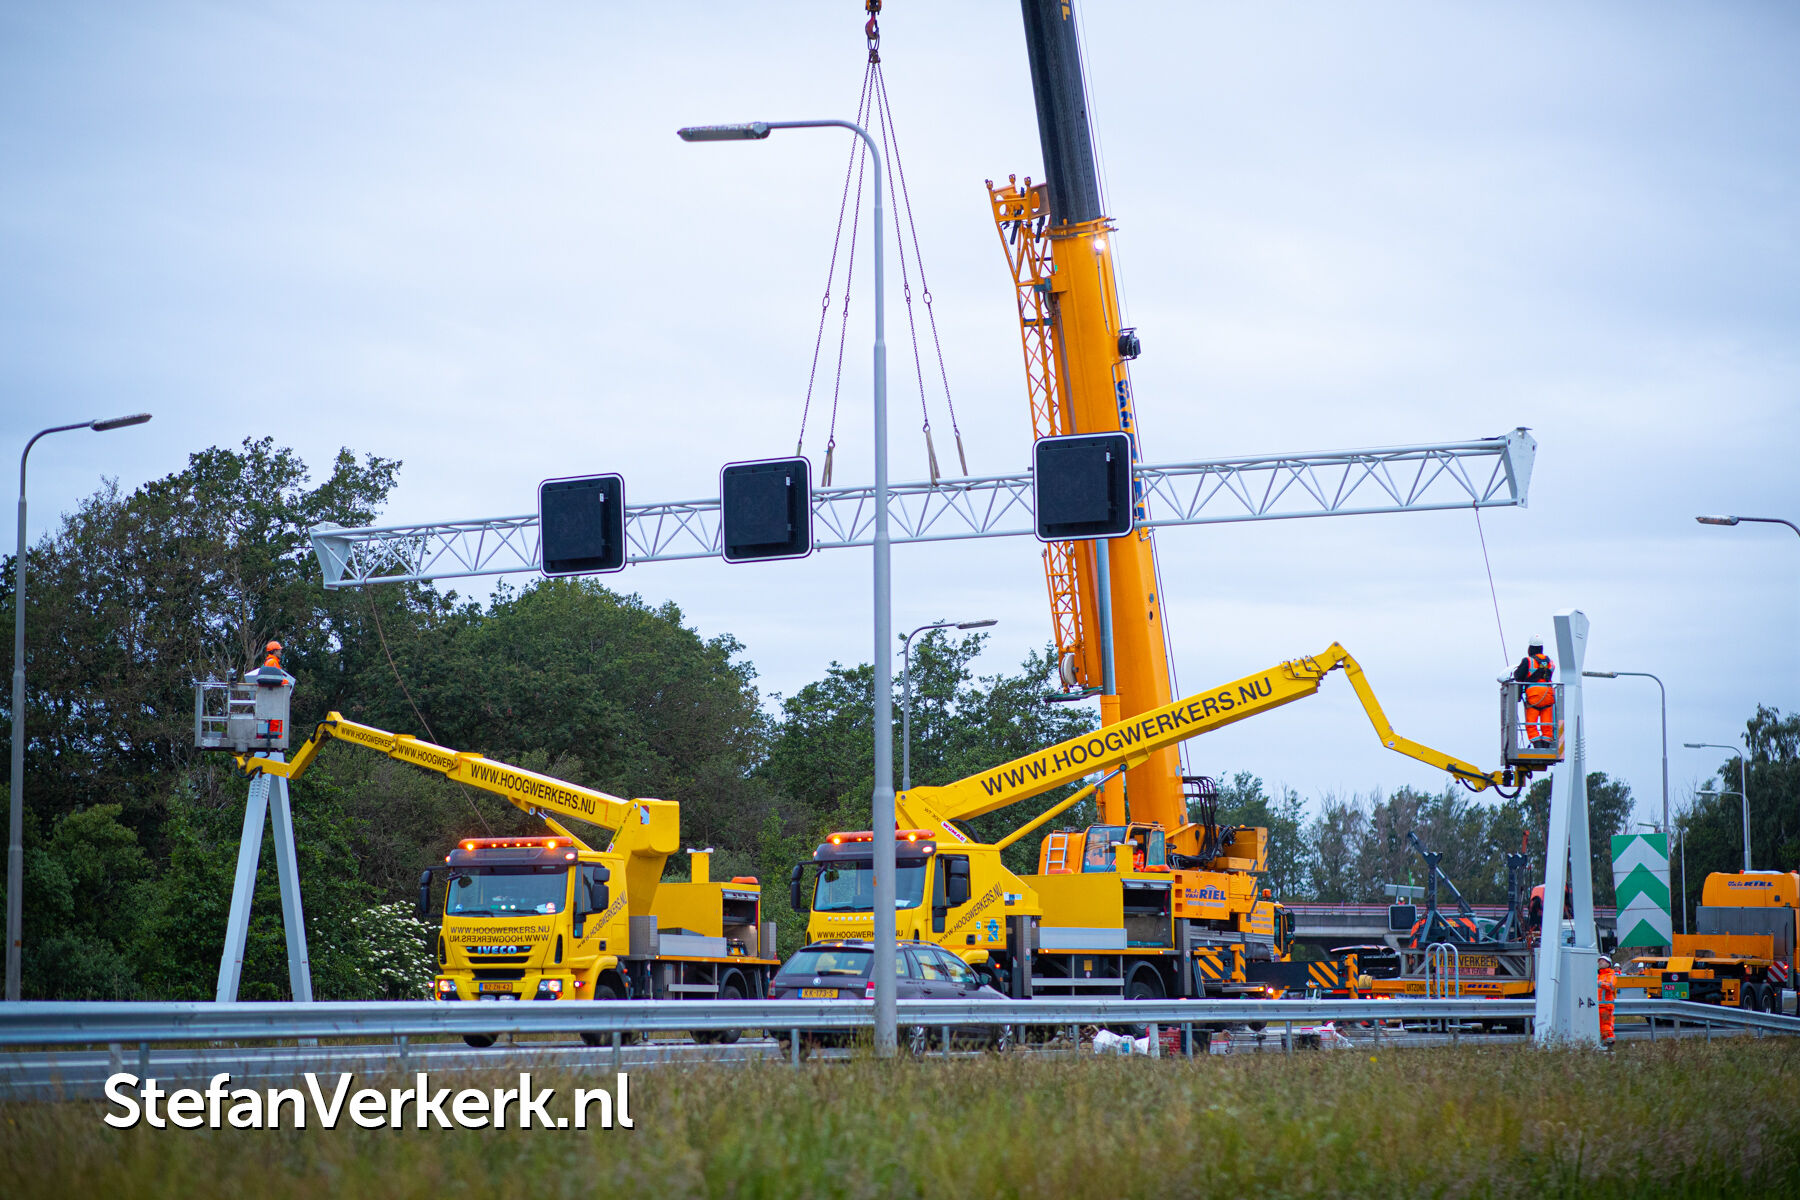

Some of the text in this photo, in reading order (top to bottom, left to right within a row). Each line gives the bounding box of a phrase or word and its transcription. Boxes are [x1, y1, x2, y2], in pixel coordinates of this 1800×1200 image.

[981, 677, 1273, 796] WWW.HOOGWERKERS.NU
[472, 764, 596, 815] WWW.HOOGWERKERS.NU
[1199, 889, 1226, 900] RIEL
[937, 882, 1003, 943] WWW.HOOGWERKERS.NU
[451, 926, 550, 935] WWW.HOOGWERKERS.NU
[477, 946, 517, 954] IVECO
